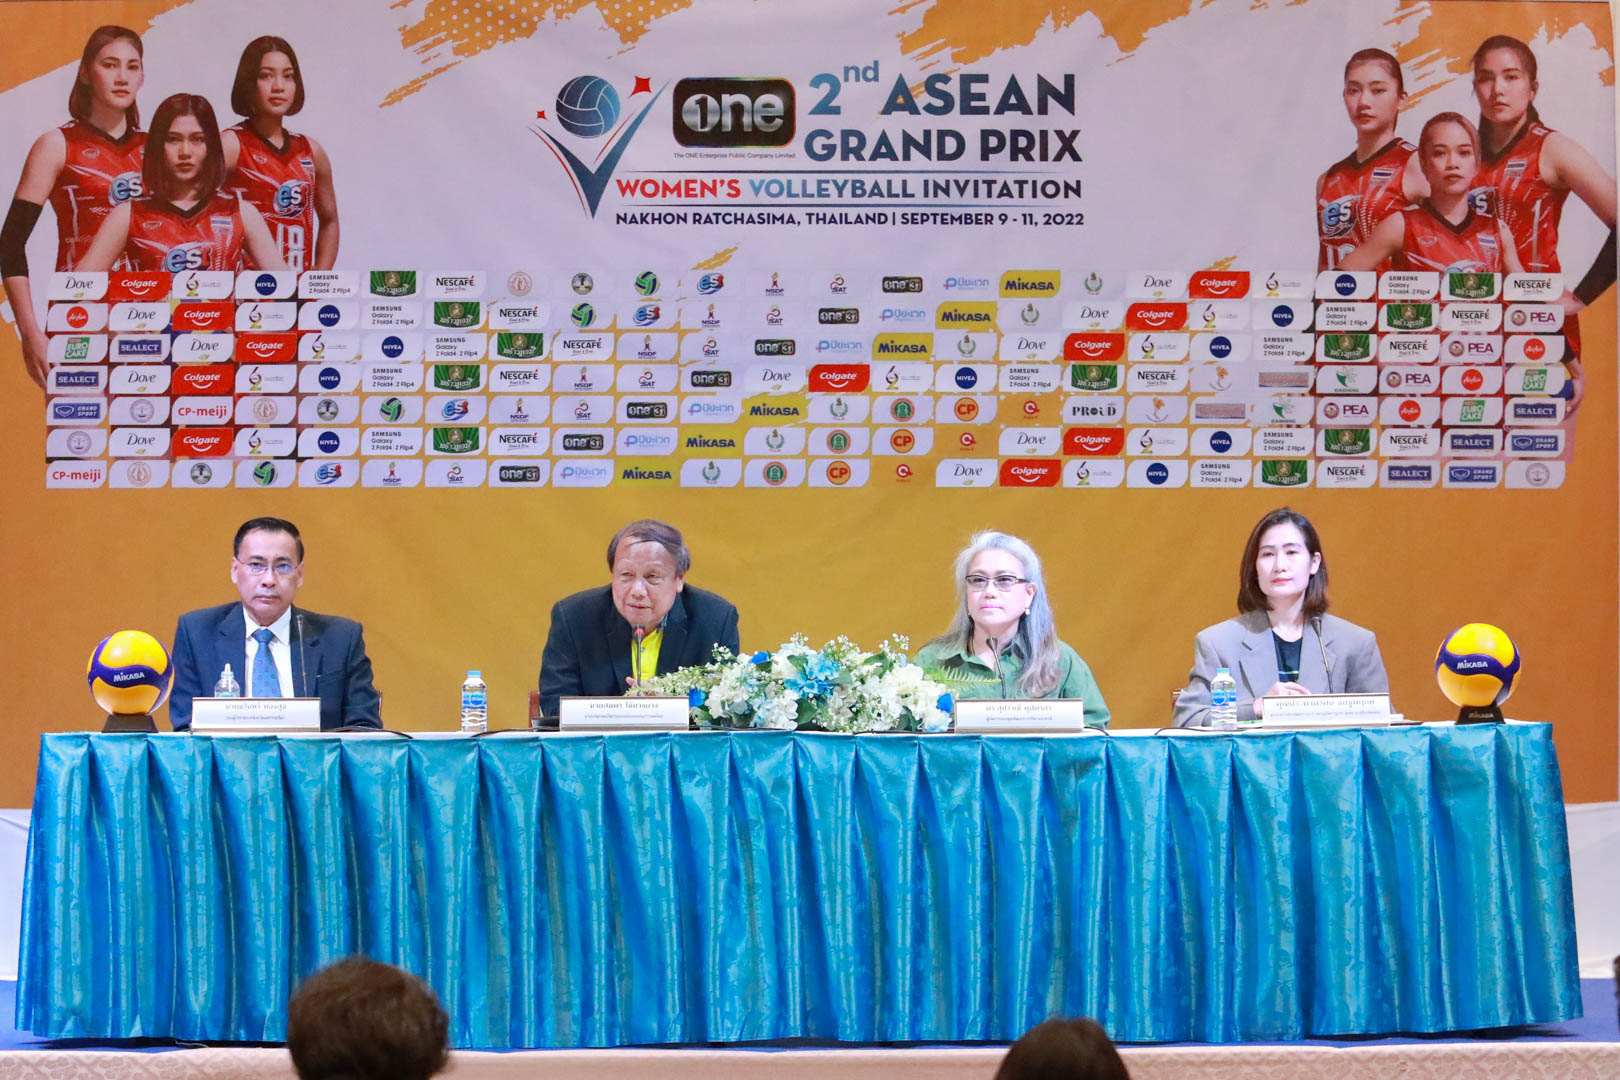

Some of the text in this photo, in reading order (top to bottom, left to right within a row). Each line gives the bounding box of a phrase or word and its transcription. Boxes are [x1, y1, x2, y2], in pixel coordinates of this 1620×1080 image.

[882, 73, 1075, 116] ASEAN
[804, 129, 1083, 162] GRAND PRIX
[699, 152, 728, 160] Enterprise
[747, 152, 774, 161] Company
[616, 179, 1082, 199] WOMEN'S VOLLEYBALL INVITATION
[616, 212, 688, 225] NAKHON
[692, 212, 801, 227] RATCHASIMA,
[806, 212, 888, 225] THAILAND
[900, 212, 995, 226] SEPTEMBER
[998, 212, 1009, 226] 9
[1021, 212, 1039, 228] 11,
[1042, 212, 1085, 226] 2022
[65, 276, 94, 289] Dove
[121, 279, 158, 289] Colgate
[1144, 274, 1173, 287] Dove
[1200, 278, 1237, 288] Colgate
[127, 307, 156, 320] Dove
[184, 310, 221, 320] Colgate
[1080, 306, 1109, 319] Dove
[1137, 310, 1174, 320] Colgate
[1529, 312, 1556, 322] PEA
[67, 342, 89, 350] EURO
[121, 344, 159, 352] SEALECT
[190, 338, 219, 351] Dove
[246, 341, 283, 351] Colgate
[1017, 337, 1046, 350] Dove
[1075, 340, 1112, 350] Colgate
[1467, 343, 1494, 353] PEA
[66, 350, 87, 358] CAKE
[128, 370, 157, 383] Dove
[184, 373, 221, 383] Colgate
[762, 368, 791, 381] Dove
[820, 372, 857, 382] Colgate
[1404, 373, 1431, 383] PEA
[1525, 374, 1547, 382] EURO
[58, 376, 96, 384] SEALECT
[1524, 382, 1545, 390] CAKE
[178, 405, 227, 419] CP-meiji
[957, 403, 976, 415] CP
[1342, 404, 1369, 414] PEA
[1462, 405, 1484, 413] EURO
[1516, 407, 1554, 415] SEALECT
[1461, 413, 1482, 421] CAKE
[127, 432, 156, 445] Dove
[183, 436, 220, 446] Colgate
[893, 435, 912, 447] CP
[1017, 432, 1046, 445] Dove
[1074, 435, 1111, 445] Colgate
[1453, 439, 1491, 447] SEALECT
[829, 466, 848, 478] CP
[954, 463, 983, 476] Dove
[1011, 466, 1048, 476] Colgate
[1391, 470, 1429, 478] SEALECT
[52, 469, 101, 483] CP-meiji
